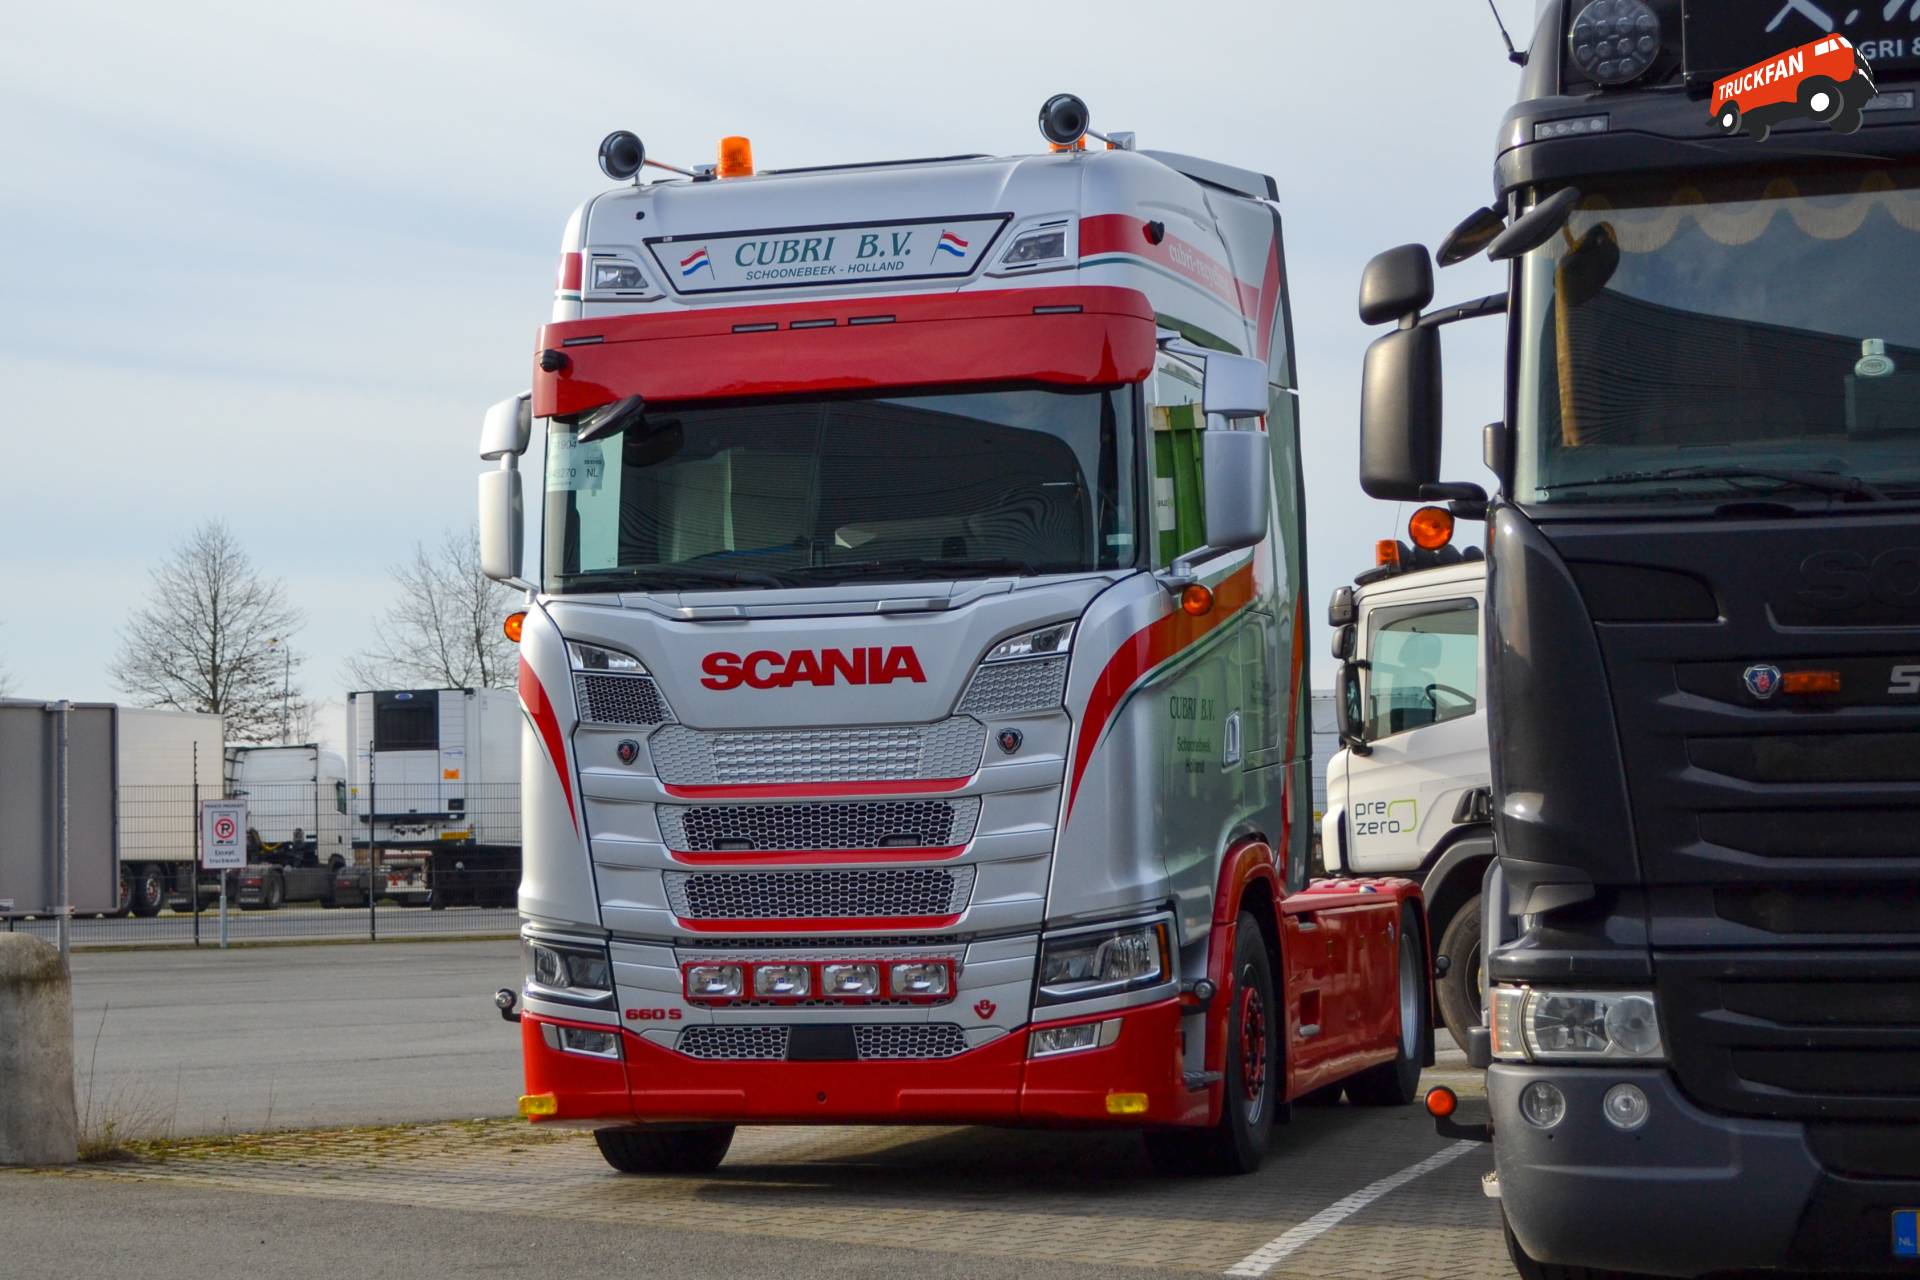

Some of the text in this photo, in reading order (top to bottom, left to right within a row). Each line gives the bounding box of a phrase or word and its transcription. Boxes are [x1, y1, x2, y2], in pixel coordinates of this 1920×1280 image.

[735, 231, 912, 267] CUBRI B.V.
[746, 265, 836, 281] SCHOONEBEEK
[847, 261, 904, 274] HOLLAND
[701, 645, 928, 691] SCANIA
[1169, 695, 1197, 720] CUBRI
[1355, 801, 1387, 820] pre
[1356, 820, 1400, 836] zero
[625, 1008, 683, 1020] 660 S
